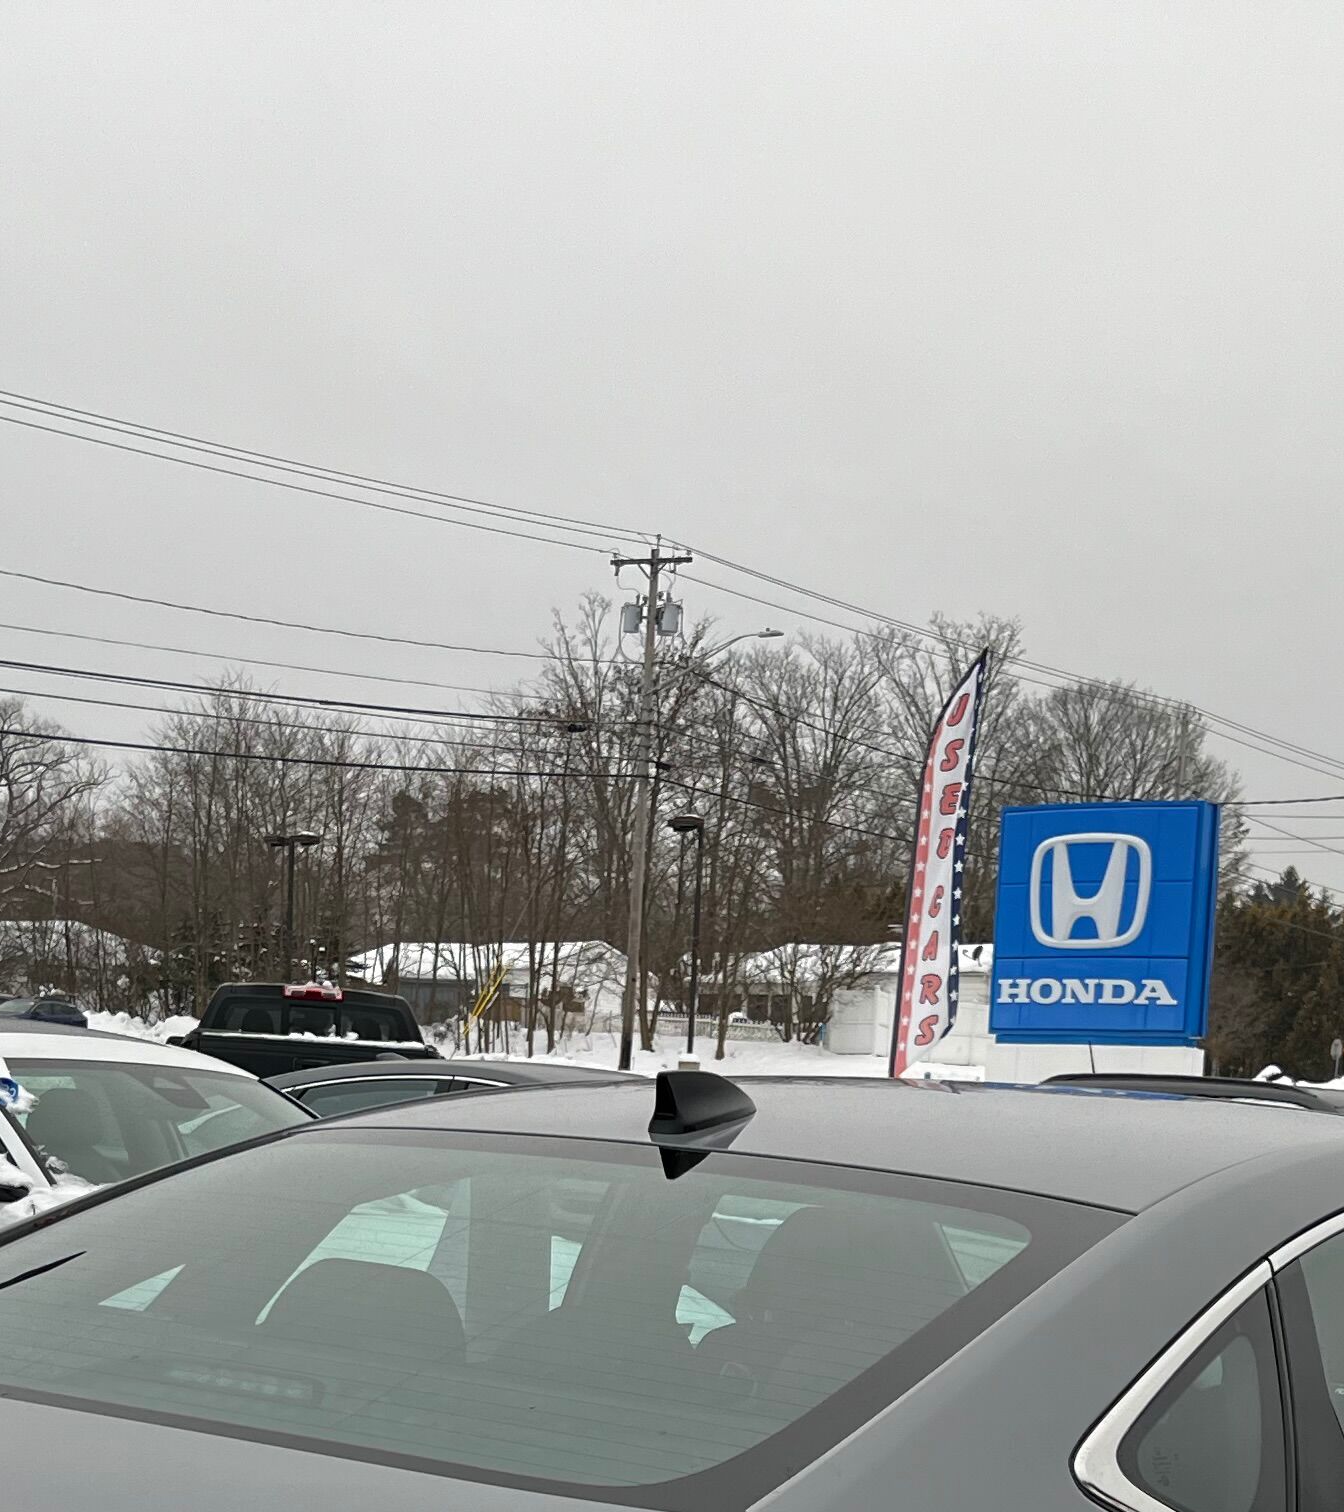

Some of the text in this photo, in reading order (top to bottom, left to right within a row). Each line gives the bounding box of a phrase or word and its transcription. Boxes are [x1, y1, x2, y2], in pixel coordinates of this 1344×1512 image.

[914, 692, 970, 1046] USED CARS
[996, 977, 1178, 1007] HONDA
